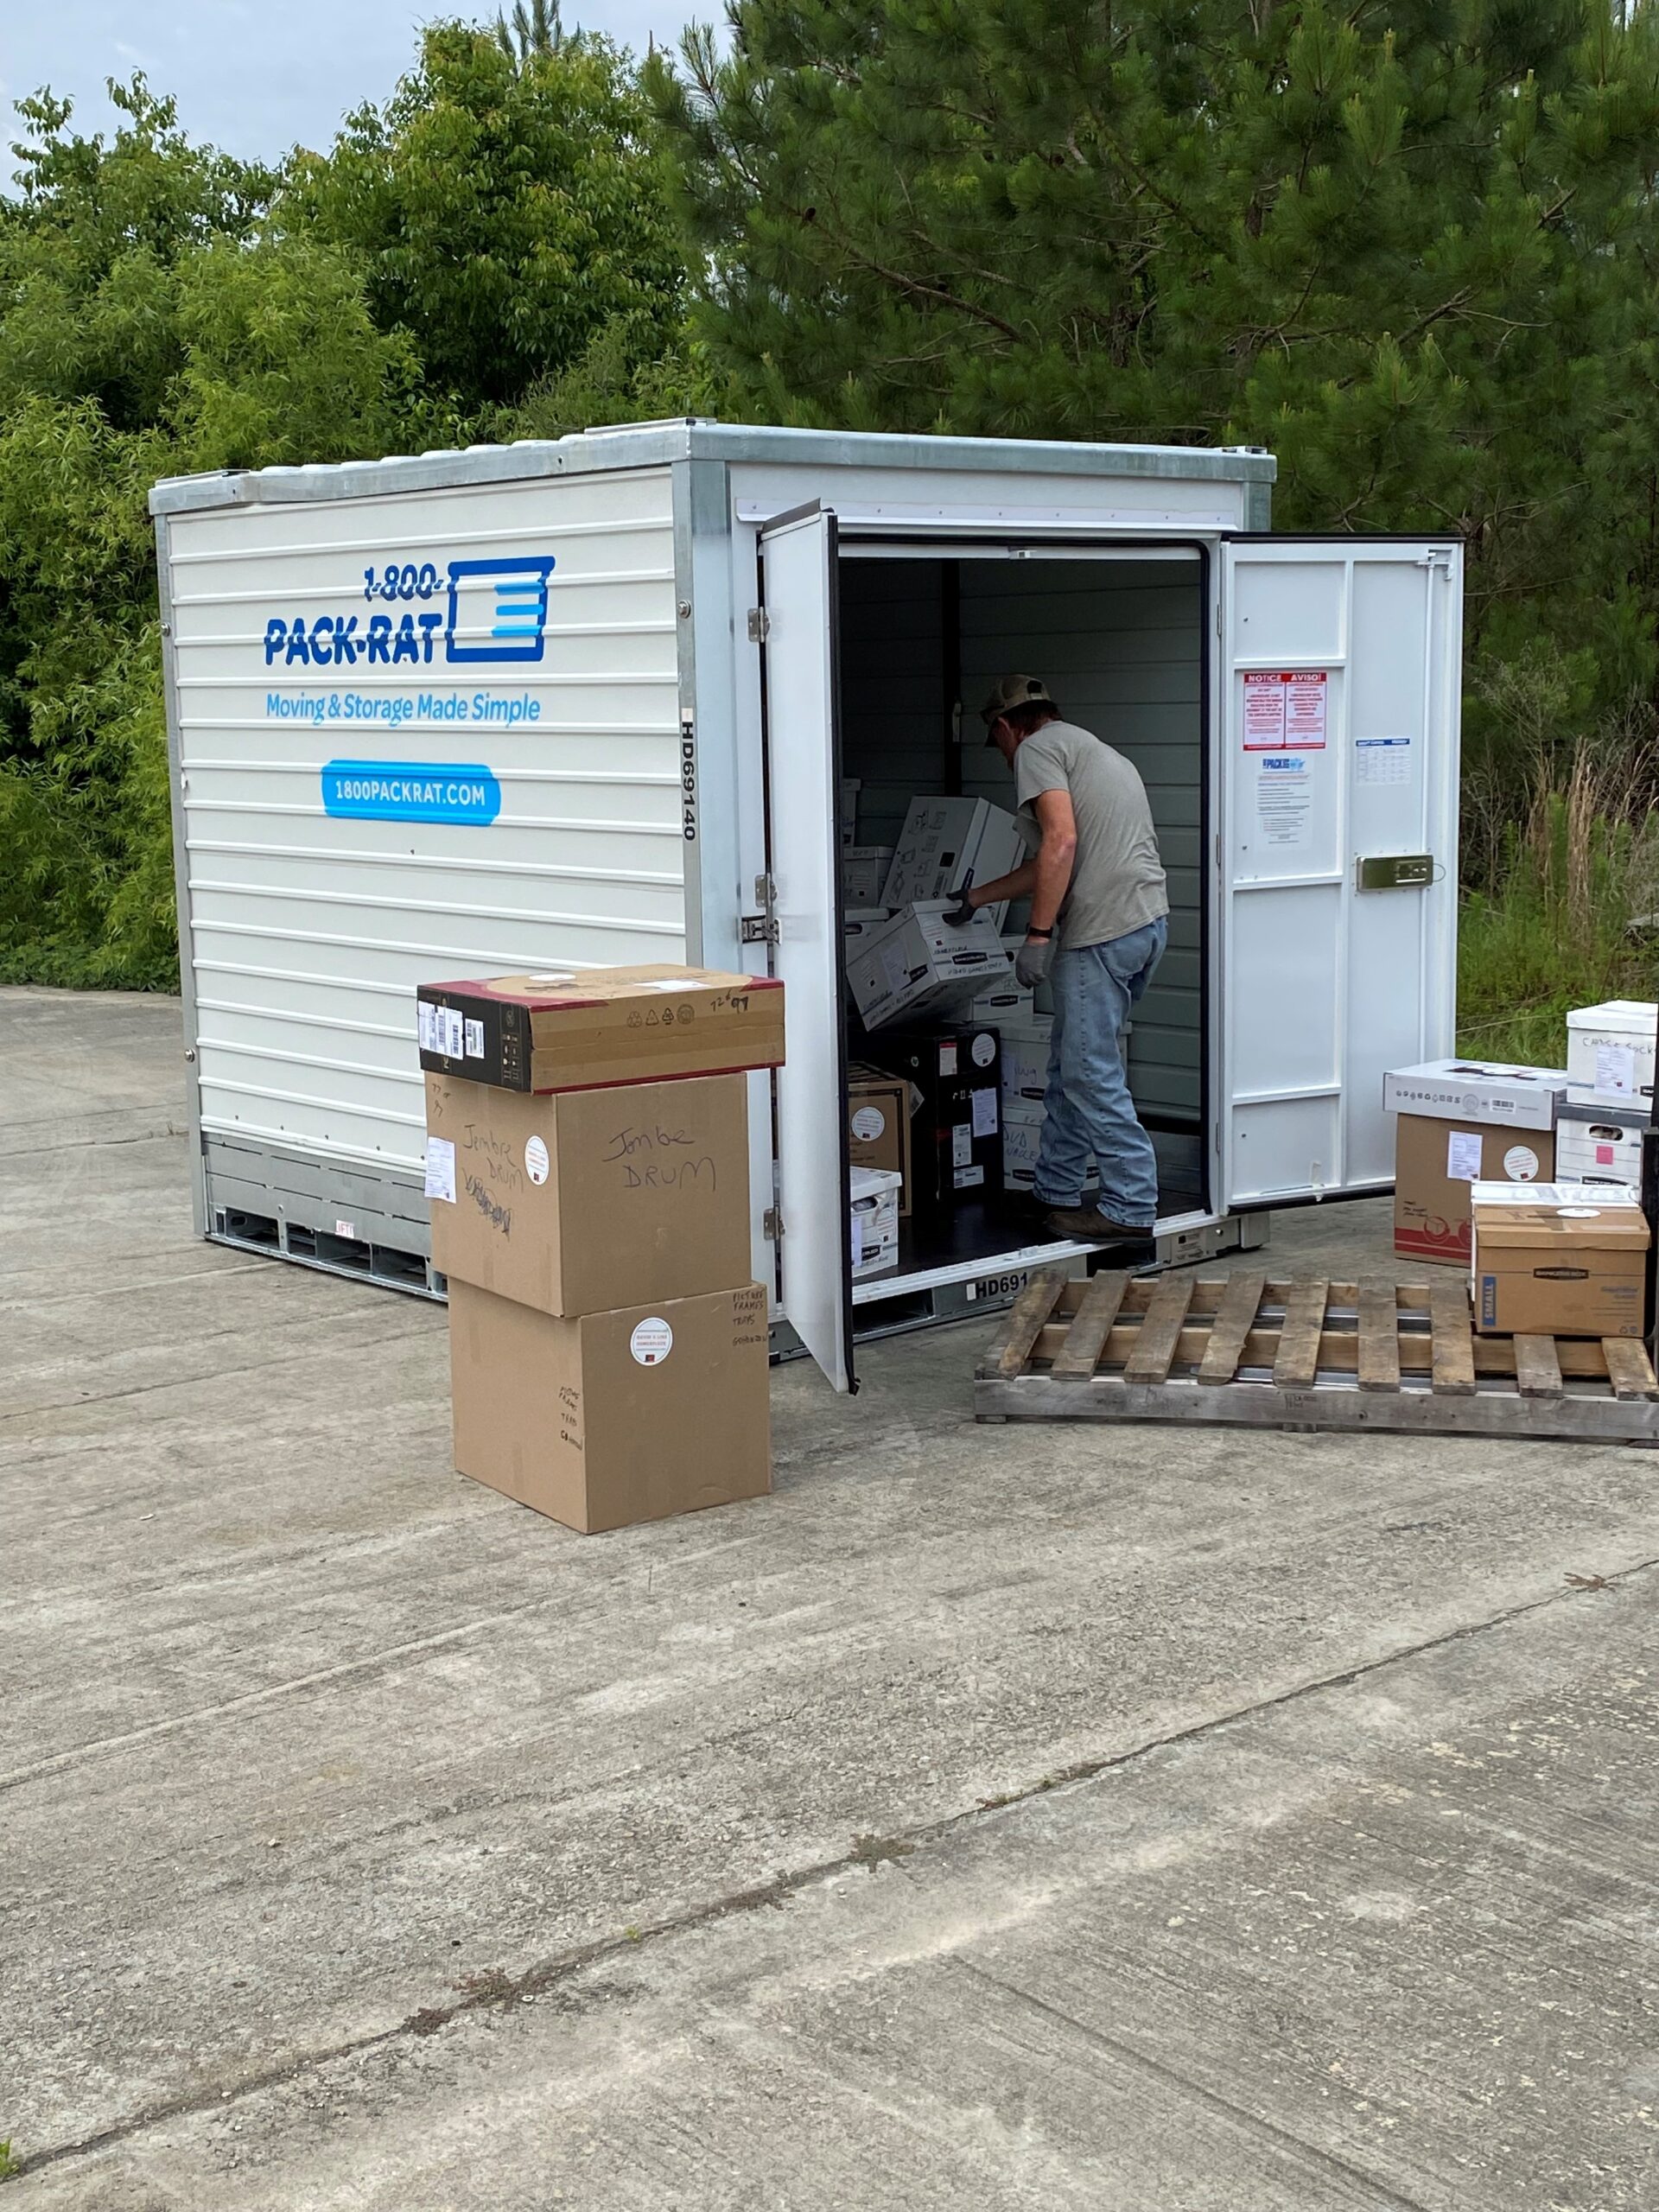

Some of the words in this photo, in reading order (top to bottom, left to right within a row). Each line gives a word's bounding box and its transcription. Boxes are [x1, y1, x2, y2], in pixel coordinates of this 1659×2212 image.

[364, 563, 444, 602] 1-800-
[264, 613, 442, 665] PACK-RAT
[1248, 674, 1282, 683] NOTICE
[266, 691, 324, 726] Moving
[327, 693, 341, 719] &
[344, 692, 413, 728] Storage
[417, 692, 468, 720] Made
[471, 692, 541, 728] Simple
[335, 779, 486, 805] 1800PACKRAT.COM
[681, 721, 696, 841] HD69140
[622, 1156, 716, 1192] DRUM
[975, 1271, 1028, 1300] HD691
[1484, 1283, 1494, 1319] SMALL
